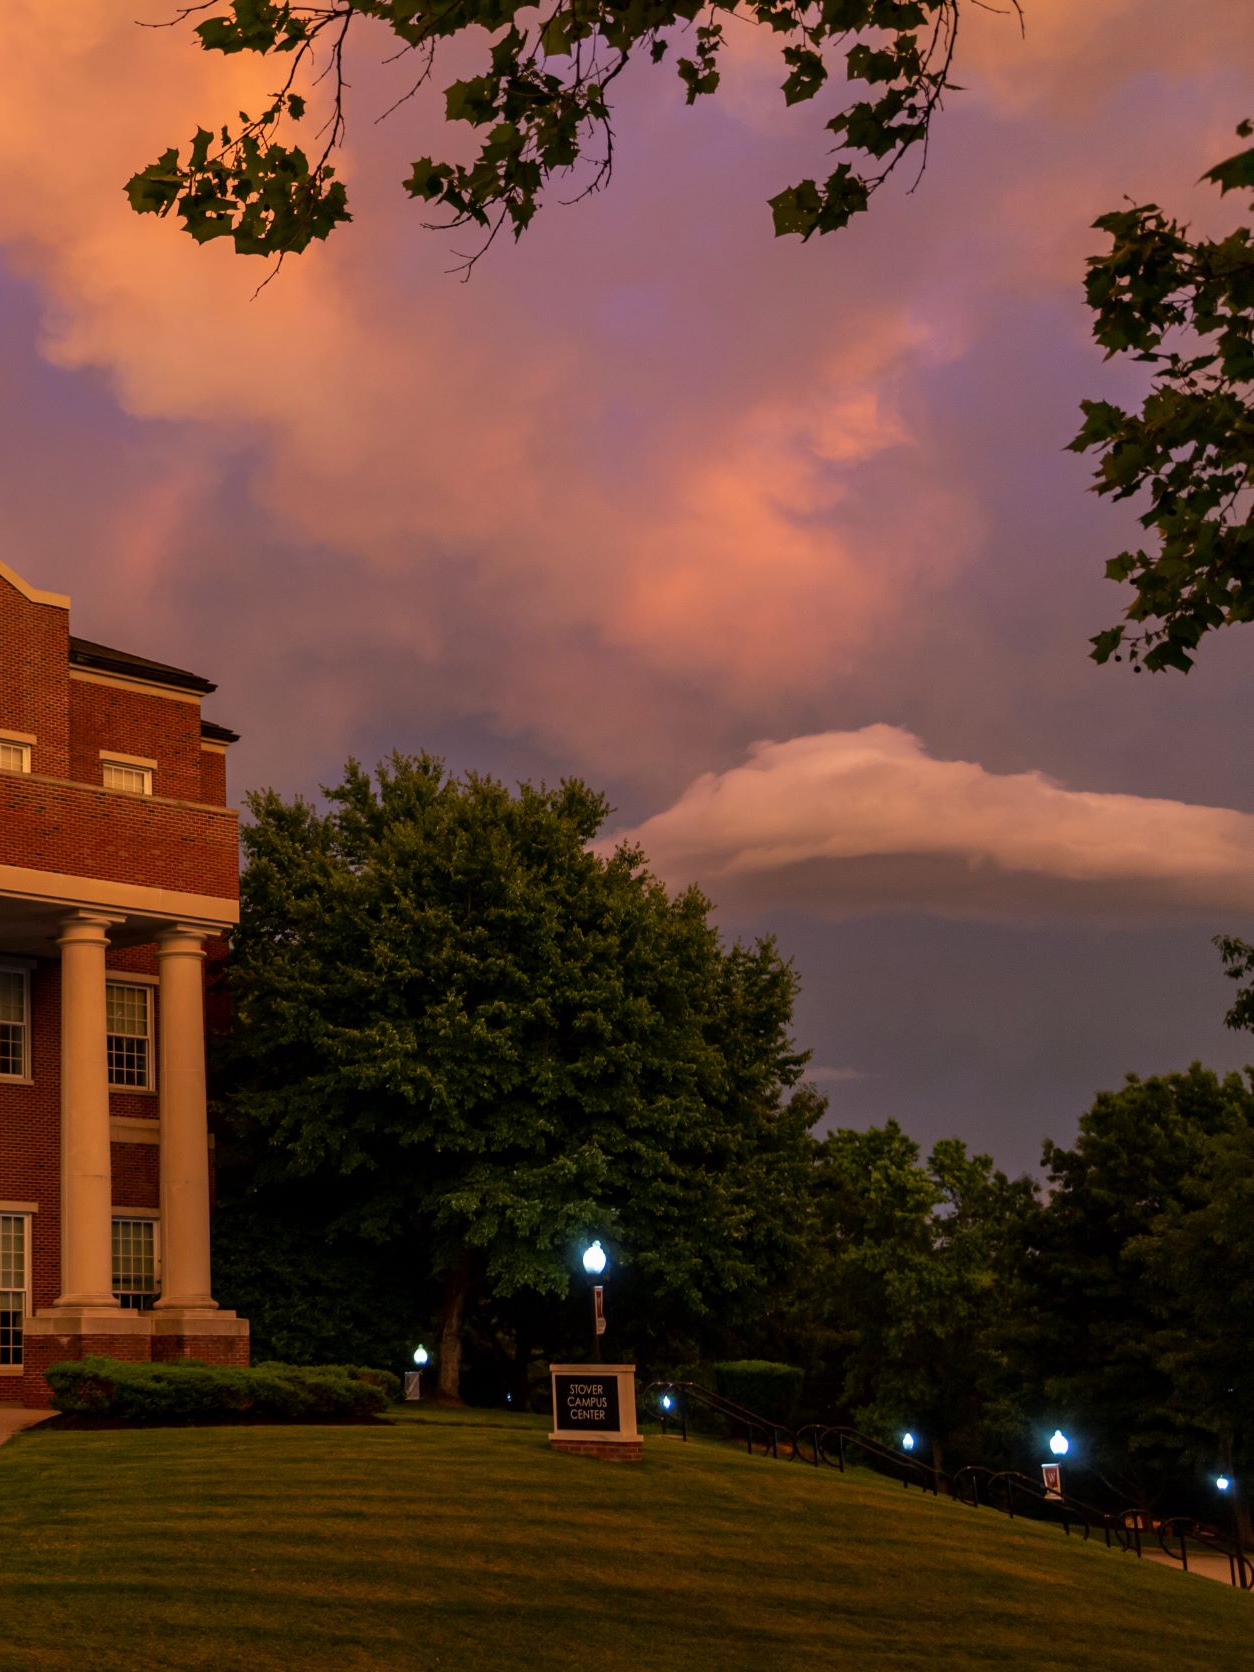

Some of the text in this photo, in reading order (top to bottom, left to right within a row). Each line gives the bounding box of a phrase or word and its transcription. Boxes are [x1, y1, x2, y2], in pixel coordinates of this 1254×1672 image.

[569, 1384, 604, 1395] STOVER
[567, 1396, 607, 1408] CAMPUS
[570, 1409, 606, 1420] CENTER
